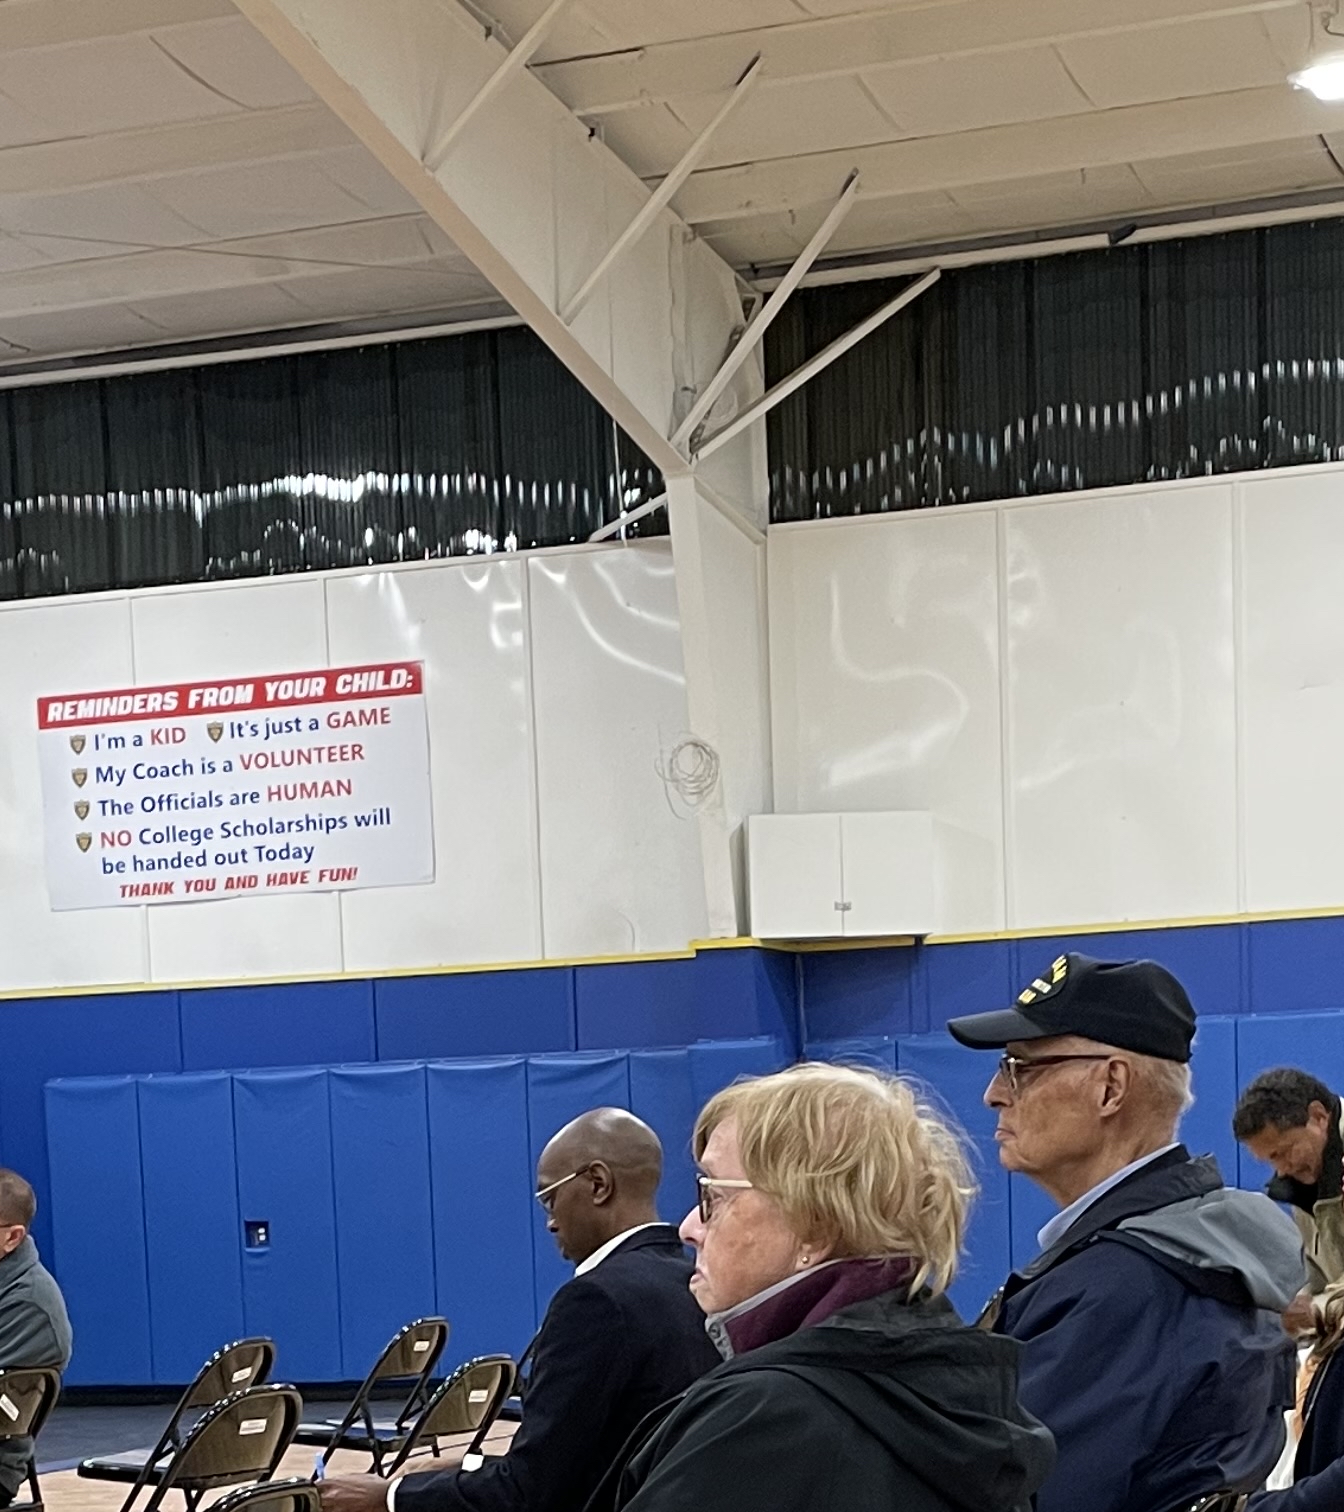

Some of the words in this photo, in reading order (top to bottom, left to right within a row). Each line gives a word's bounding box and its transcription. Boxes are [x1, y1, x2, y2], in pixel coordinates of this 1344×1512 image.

[47, 690, 179, 723] REMINDERS
[188, 683, 254, 709] FROM
[264, 676, 327, 702] YOUR
[335, 668, 413, 695] CHILD:
[94, 733, 126, 751] I'm
[132, 734, 144, 747] a
[150, 726, 187, 746] KID
[230, 719, 259, 739] It's
[263, 716, 303, 741] just
[308, 717, 320, 731] a
[326, 706, 392, 730] GAME
[95, 765, 127, 787] My
[133, 758, 195, 780] Coach
[200, 756, 217, 775] is
[222, 759, 234, 773] a
[240, 743, 365, 771] VOLUNTEER
[97, 798, 135, 817] The
[140, 789, 224, 813] Officials
[229, 790, 261, 806] are
[267, 778, 353, 803] HUMAN
[100, 829, 133, 849] NO
[138, 824, 215, 847] College
[220, 812, 348, 839] Scholarships
[353, 806, 391, 828] will
[102, 856, 127, 875] be
[132, 848, 207, 873] handed
[214, 848, 249, 866] out
[253, 841, 315, 864] Today
[119, 880, 175, 899] THANK
[184, 877, 217, 894] YOU
[224, 874, 259, 891] AND
[266, 869, 312, 887] HAVE
[317, 866, 359, 884] FUN!
